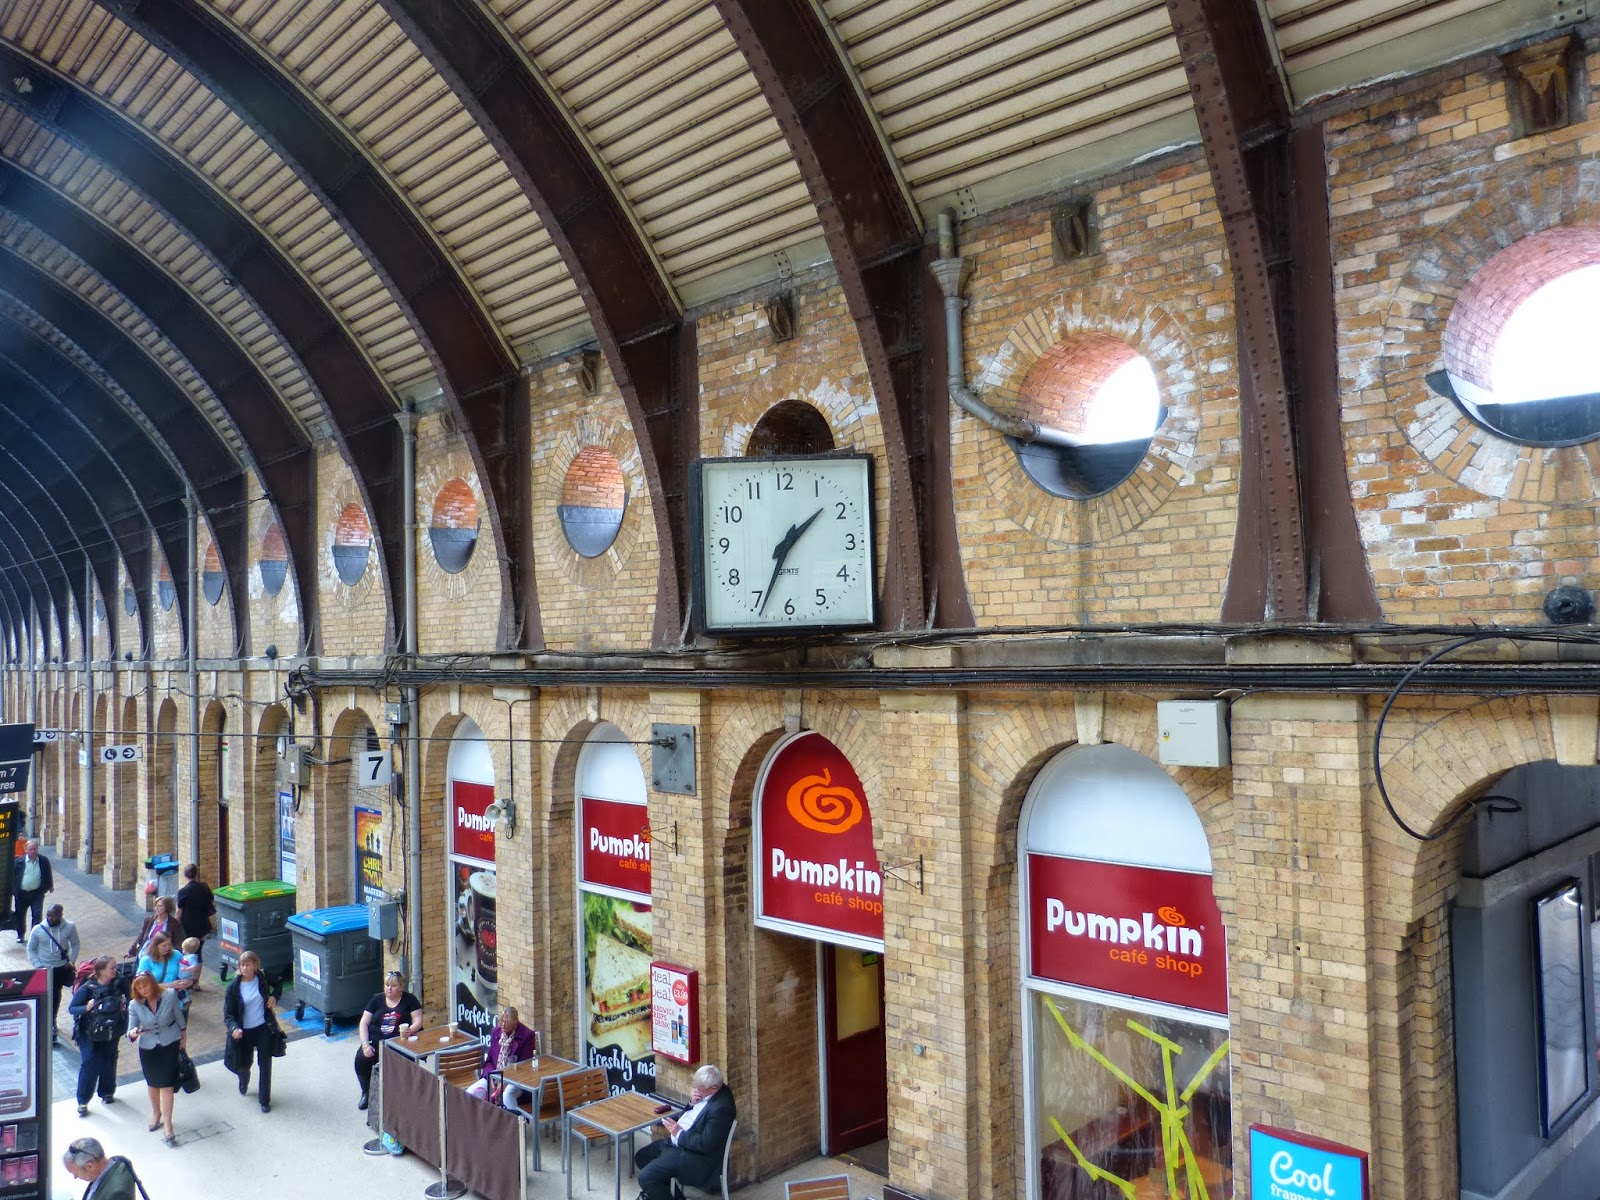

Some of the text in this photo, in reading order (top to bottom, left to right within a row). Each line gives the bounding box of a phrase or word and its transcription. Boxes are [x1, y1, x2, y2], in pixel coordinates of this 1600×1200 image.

[776, 472, 794, 491] 12
[814, 480, 819, 498] 1
[749, 482, 760, 500] 11
[725, 505, 743, 523] 10
[835, 502, 847, 520] 2
[719, 537, 730, 554] 9
[845, 533, 856, 551] 3
[728, 568, 740, 586] 8
[836, 564, 850, 582] 4
[751, 590, 763, 608] 7
[815, 588, 827, 606] 5
[784, 598, 796, 616] 6
[10, 767, 17, 777] 7
[368, 756, 384, 781] 7
[590, 827, 650, 861] Pumpki
[618, 859, 650, 872] café sh
[772, 848, 881, 896] Pumpkin
[814, 891, 883, 916] café shop
[1046, 897, 1202, 957] Pumpkin
[1109, 948, 1203, 978] café shop
[457, 1003, 491, 1028] Perfect
[589, 1046, 657, 1081] freshly ma
[1269, 1150, 1336, 1197] Cool
